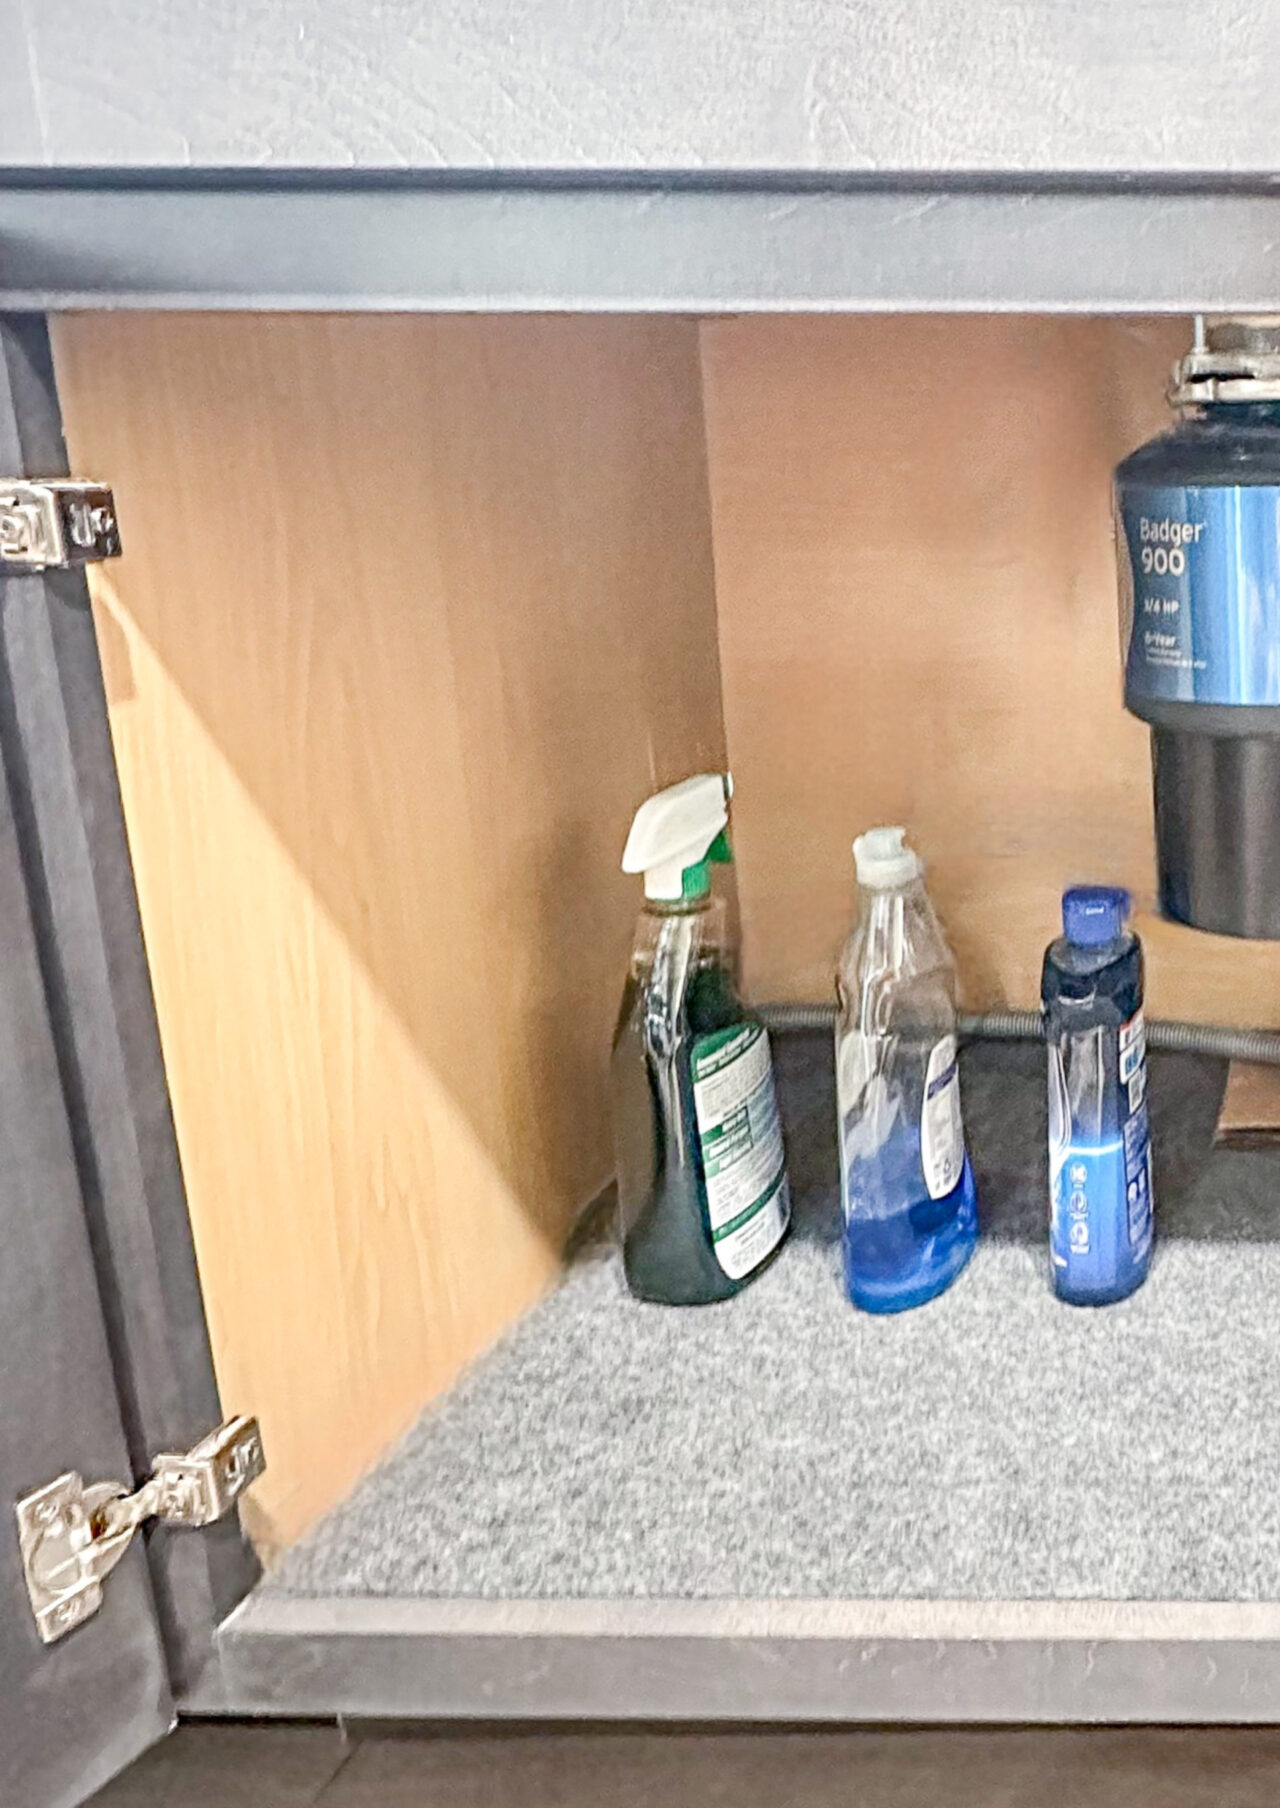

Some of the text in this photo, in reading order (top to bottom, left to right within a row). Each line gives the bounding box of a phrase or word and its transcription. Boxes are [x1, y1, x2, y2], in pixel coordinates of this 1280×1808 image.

[1140, 517, 1201, 547] Badger
[1141, 547, 1185, 577] 900
[1163, 598, 1179, 615] HP
